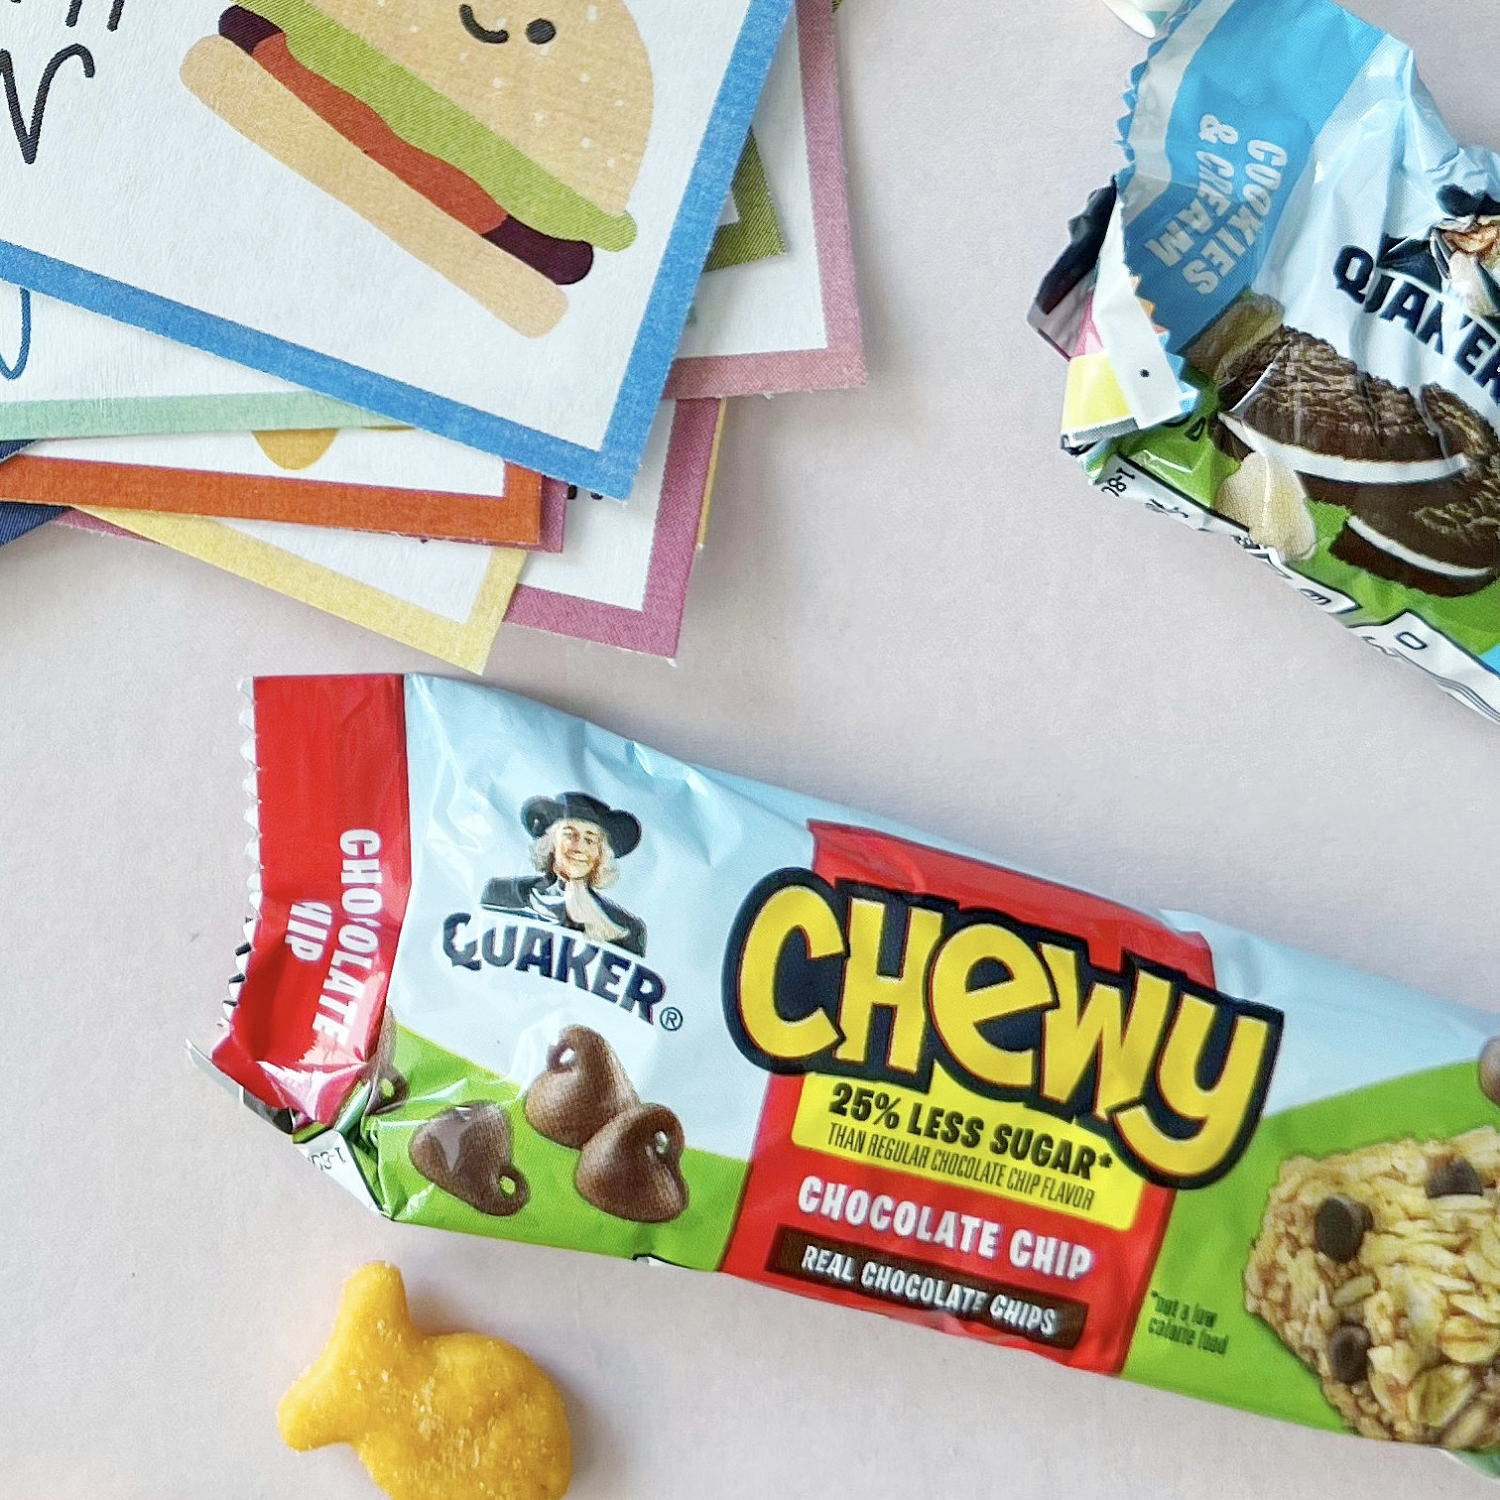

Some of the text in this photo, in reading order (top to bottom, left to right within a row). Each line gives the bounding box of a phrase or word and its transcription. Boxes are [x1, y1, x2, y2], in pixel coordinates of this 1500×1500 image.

[1197, 113, 1239, 145] &
[1181, 139, 1288, 295] COOKIES
[284, 900, 333, 962] HIP
[311, 829, 382, 1046] CHOOLATE
[828, 1082, 901, 1130] 25%
[906, 1102, 984, 1149] LESS
[827, 1121, 1095, 1211] THAN REGULAR CHOCOLATE CHIP FLAVOR
[798, 1175, 1093, 1281] CHOCOLATE CHIP
[801, 1245, 1057, 1337] REAL CHOCOLATE CHIPS
